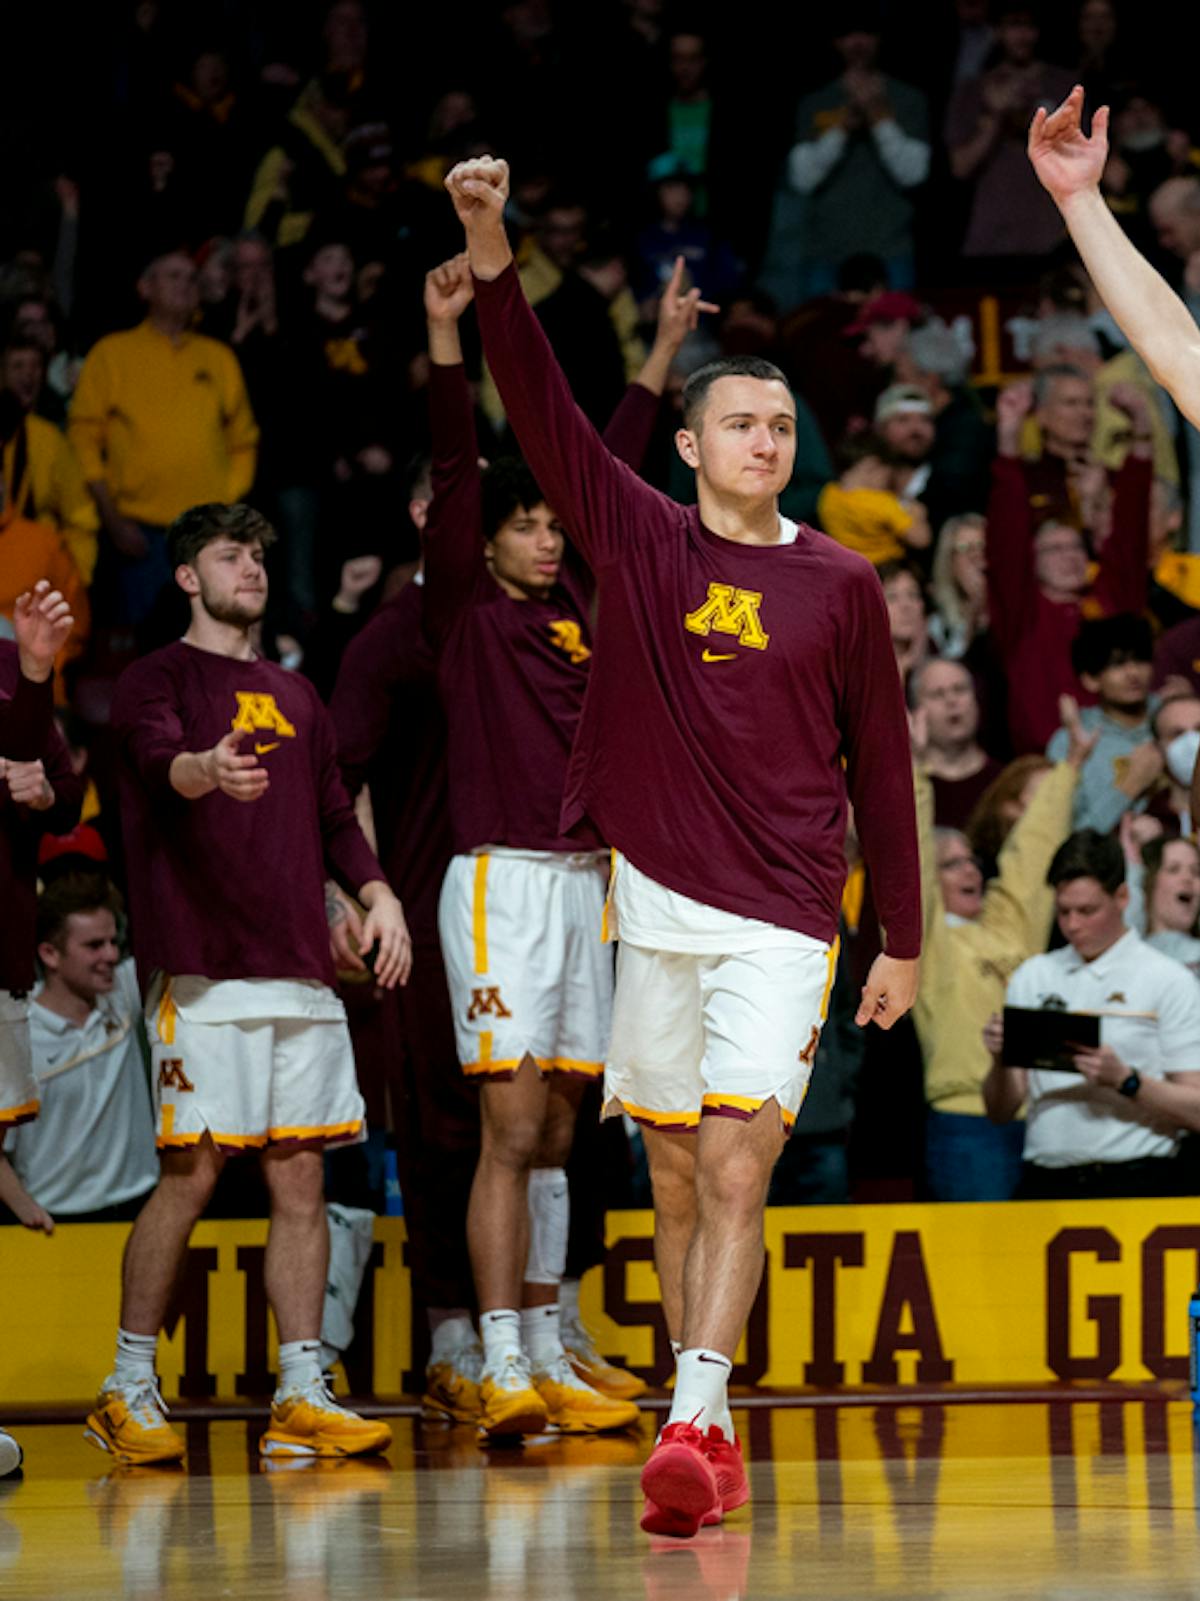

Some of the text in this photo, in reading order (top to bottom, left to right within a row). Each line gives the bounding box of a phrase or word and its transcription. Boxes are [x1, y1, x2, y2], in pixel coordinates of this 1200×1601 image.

[684, 582, 770, 651] M
[231, 691, 297, 737] M
[466, 986, 512, 1022] M
